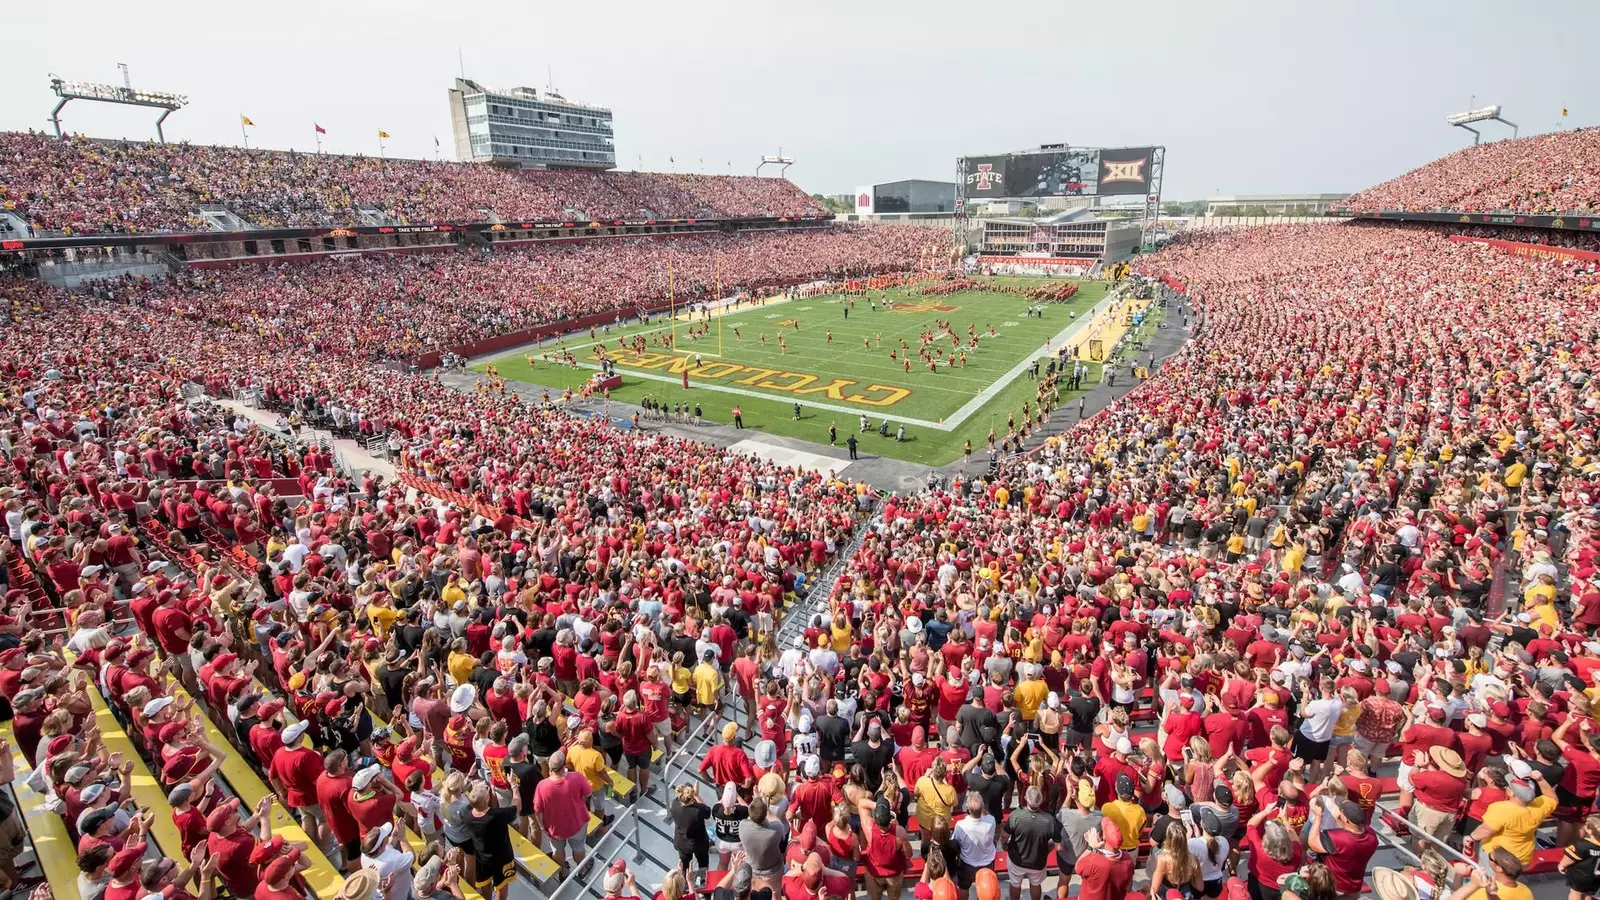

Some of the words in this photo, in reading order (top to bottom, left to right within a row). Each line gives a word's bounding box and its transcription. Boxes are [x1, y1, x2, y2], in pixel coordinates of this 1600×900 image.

[966, 170, 1002, 184] STATE
[1105, 162, 1145, 181] XII
[801, 742, 812, 754] 11
